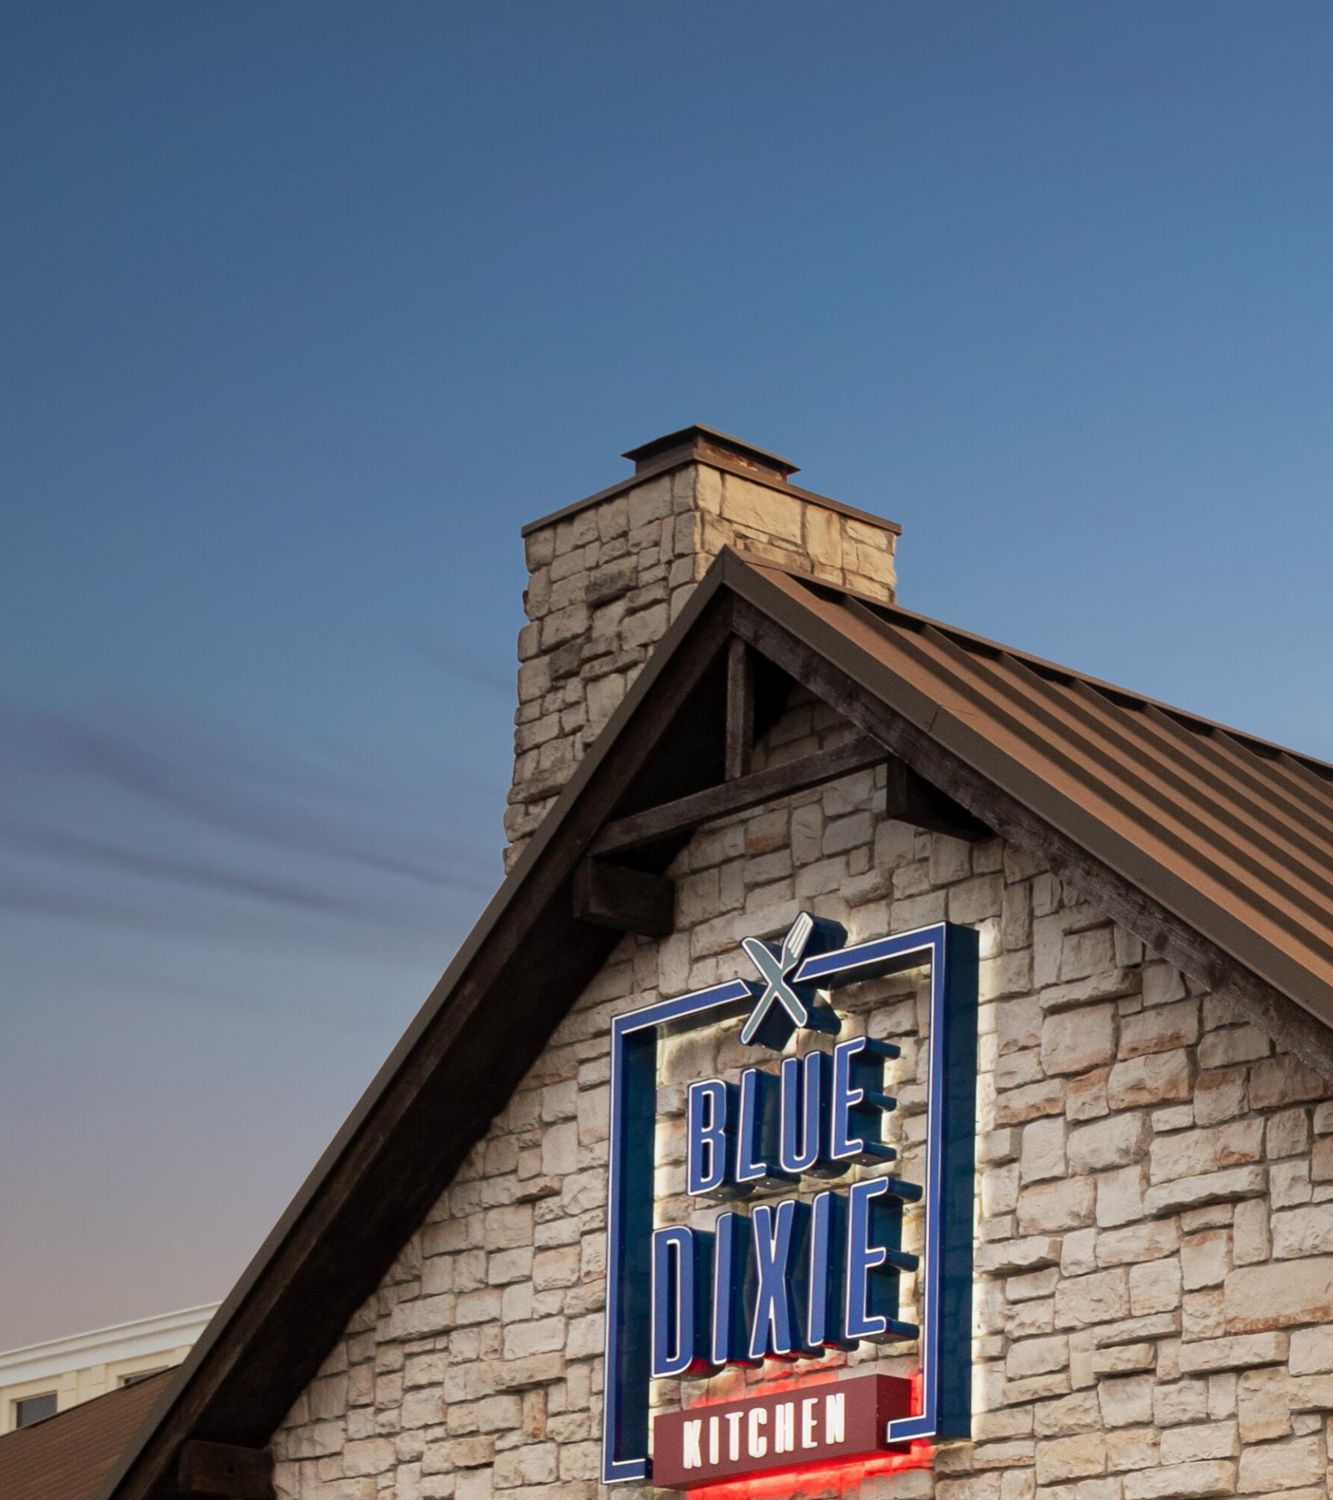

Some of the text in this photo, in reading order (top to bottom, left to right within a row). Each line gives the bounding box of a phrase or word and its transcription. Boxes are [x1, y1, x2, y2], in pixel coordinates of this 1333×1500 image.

[688, 1036, 868, 1196] BLUE
[651, 1177, 890, 1378] DIXIE
[683, 1393, 845, 1469] KITCHEN
